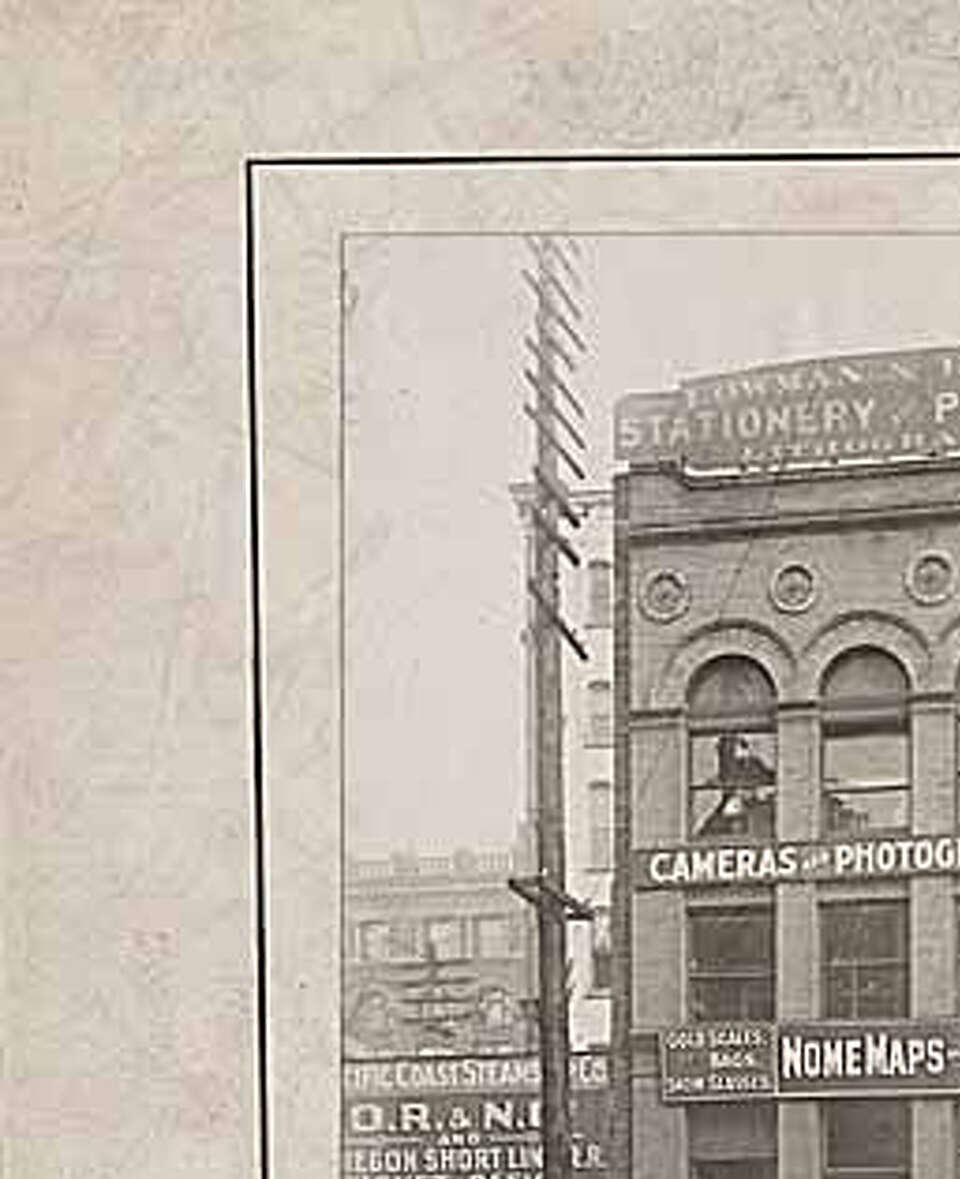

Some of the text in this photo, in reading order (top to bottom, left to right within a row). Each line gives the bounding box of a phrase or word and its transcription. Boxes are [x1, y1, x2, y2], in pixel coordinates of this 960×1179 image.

[618, 400, 874, 448] STATIONERY
[649, 846, 798, 884] CAMERAS
[781, 1036, 864, 1080] NOME
[864, 1033, 947, 1076] MAPS
[423, 1147, 502, 1172] SHORT
